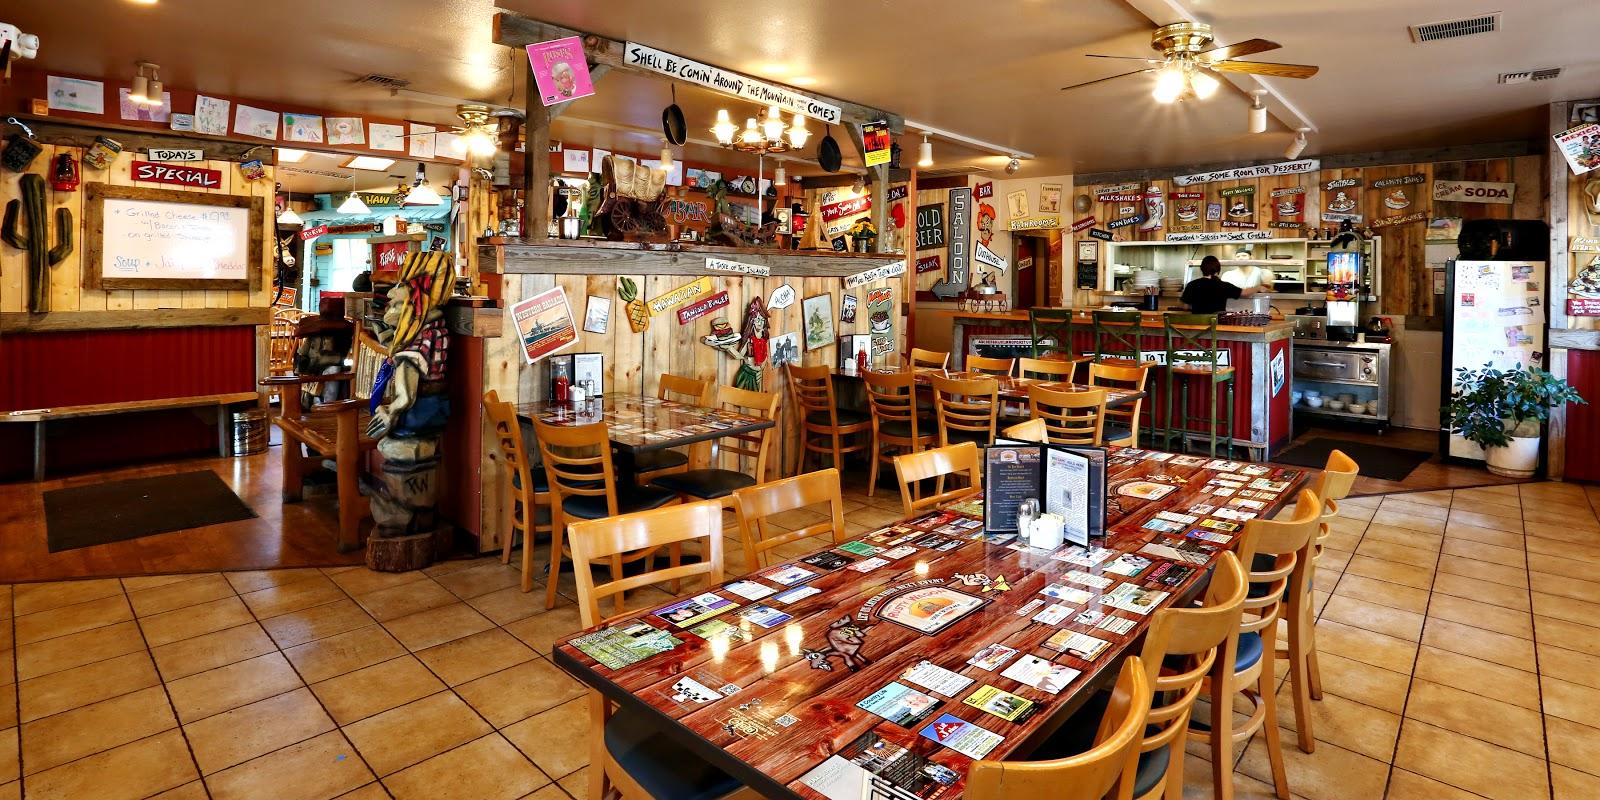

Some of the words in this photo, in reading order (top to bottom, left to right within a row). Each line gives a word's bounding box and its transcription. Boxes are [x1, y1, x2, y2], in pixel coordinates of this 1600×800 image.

[631, 48, 662, 69] SHE'LL
[666, 59, 678, 73] BE
[680, 65, 712, 83] COMIN'
[714, 73, 743, 94] AROUND
[747, 84, 759, 97] THE
[760, 88, 794, 107] MOUNTAIN
[807, 102, 835, 121] COMES
[1561, 126, 1598, 143] MEXICO
[155, 150, 196, 160] TODAY'S
[138, 165, 218, 186] SPECIAL
[1186, 175, 1205, 184] SAVE
[1208, 172, 1230, 180] SOME
[1233, 169, 1254, 177] ROOM
[1273, 161, 1312, 173] DESSERT!
[979, 185, 991, 197] BAR
[1435, 185, 1462, 199] CREAM
[1436, 182, 1447, 190] ICE
[1464, 188, 1509, 198] SODA
[366, 195, 390, 205] HAW
[126, 208, 160, 218] Grilled
[166, 211, 199, 221] Cheese
[674, 200, 711, 224] BAR
[916, 209, 940, 228] OLD
[953, 194, 965, 284] SALOON
[114, 256, 140, 272] Soup
[710, 261, 715, 269] A
[653, 281, 702, 312] HAWAIIAN
